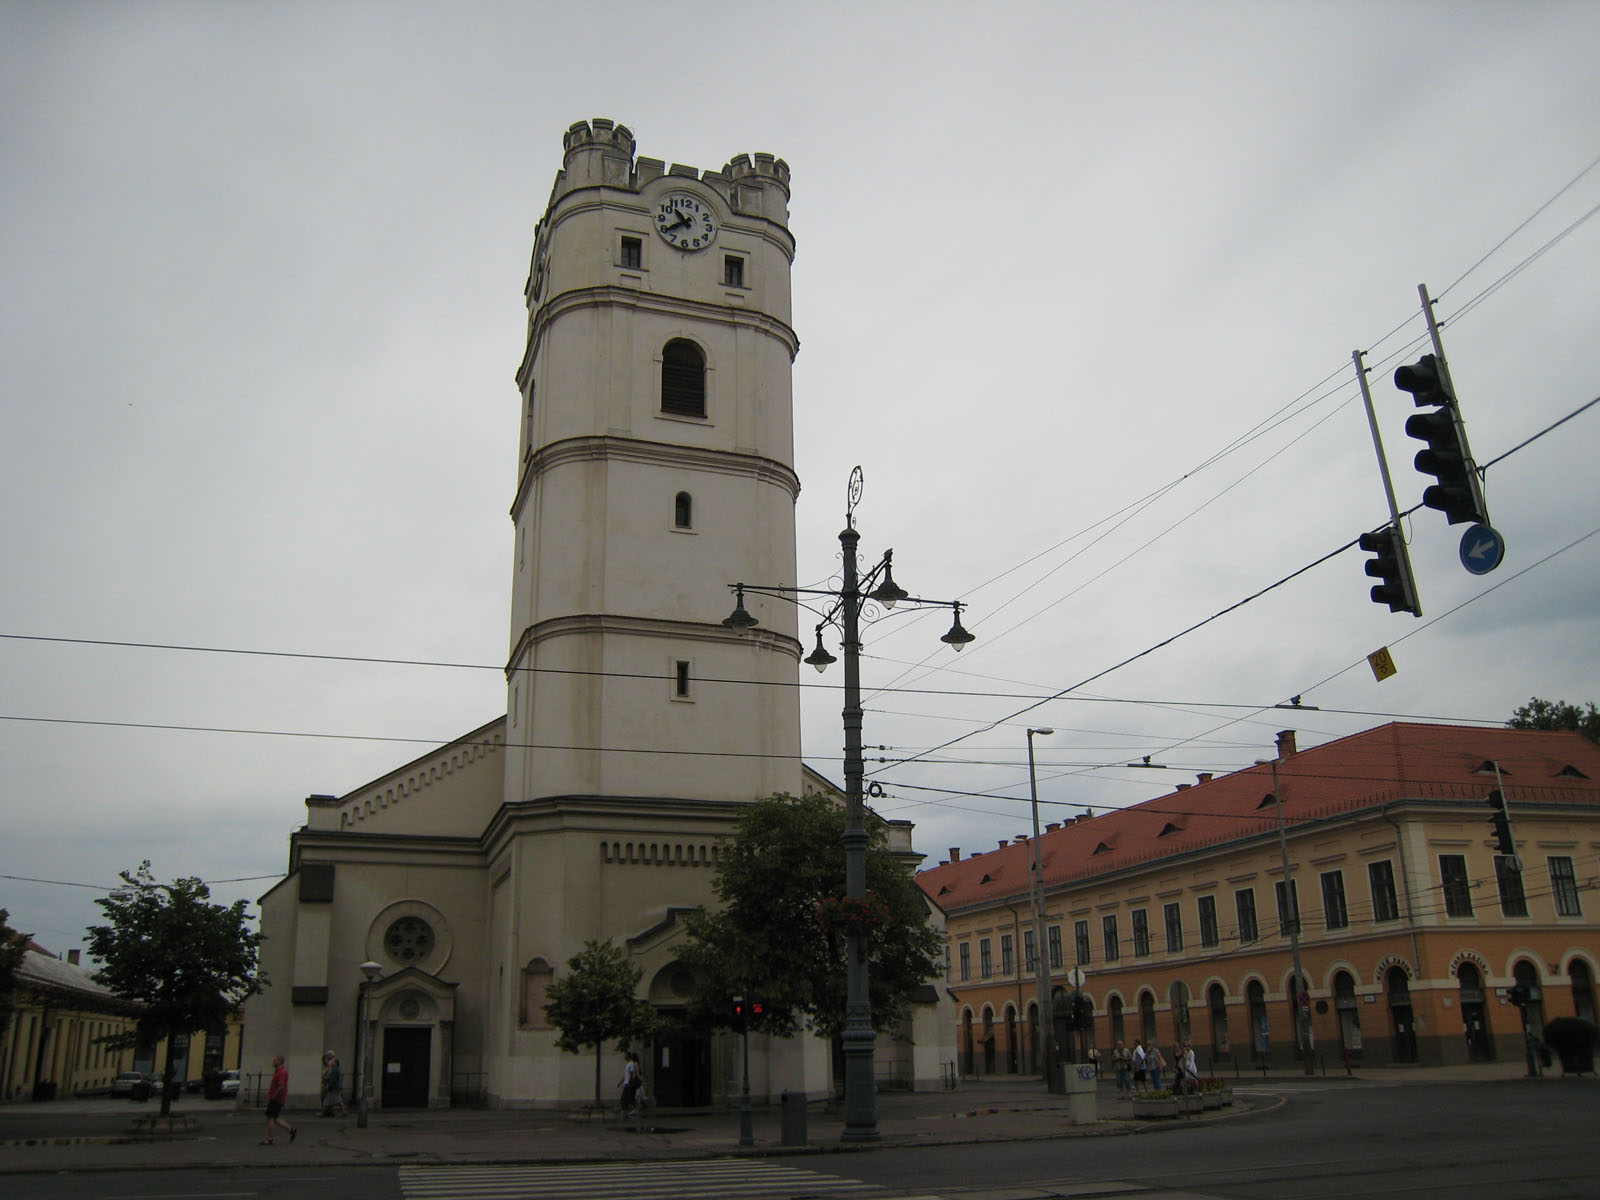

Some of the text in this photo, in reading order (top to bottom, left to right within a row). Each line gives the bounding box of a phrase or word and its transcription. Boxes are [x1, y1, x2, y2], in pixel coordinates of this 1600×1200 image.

[669, 198, 678, 208] 11
[680, 198, 693, 209] 12
[660, 204, 673, 214] 10
[694, 204, 699, 213] 1
[657, 214, 666, 222] 9
[702, 213, 710, 222] 2
[660, 224, 668, 234] 8
[705, 223, 713, 232] 3
[669, 233, 678, 242] 7
[701, 233, 709, 242] 4
[680, 239, 689, 248] 6
[692, 238, 700, 247] 5
